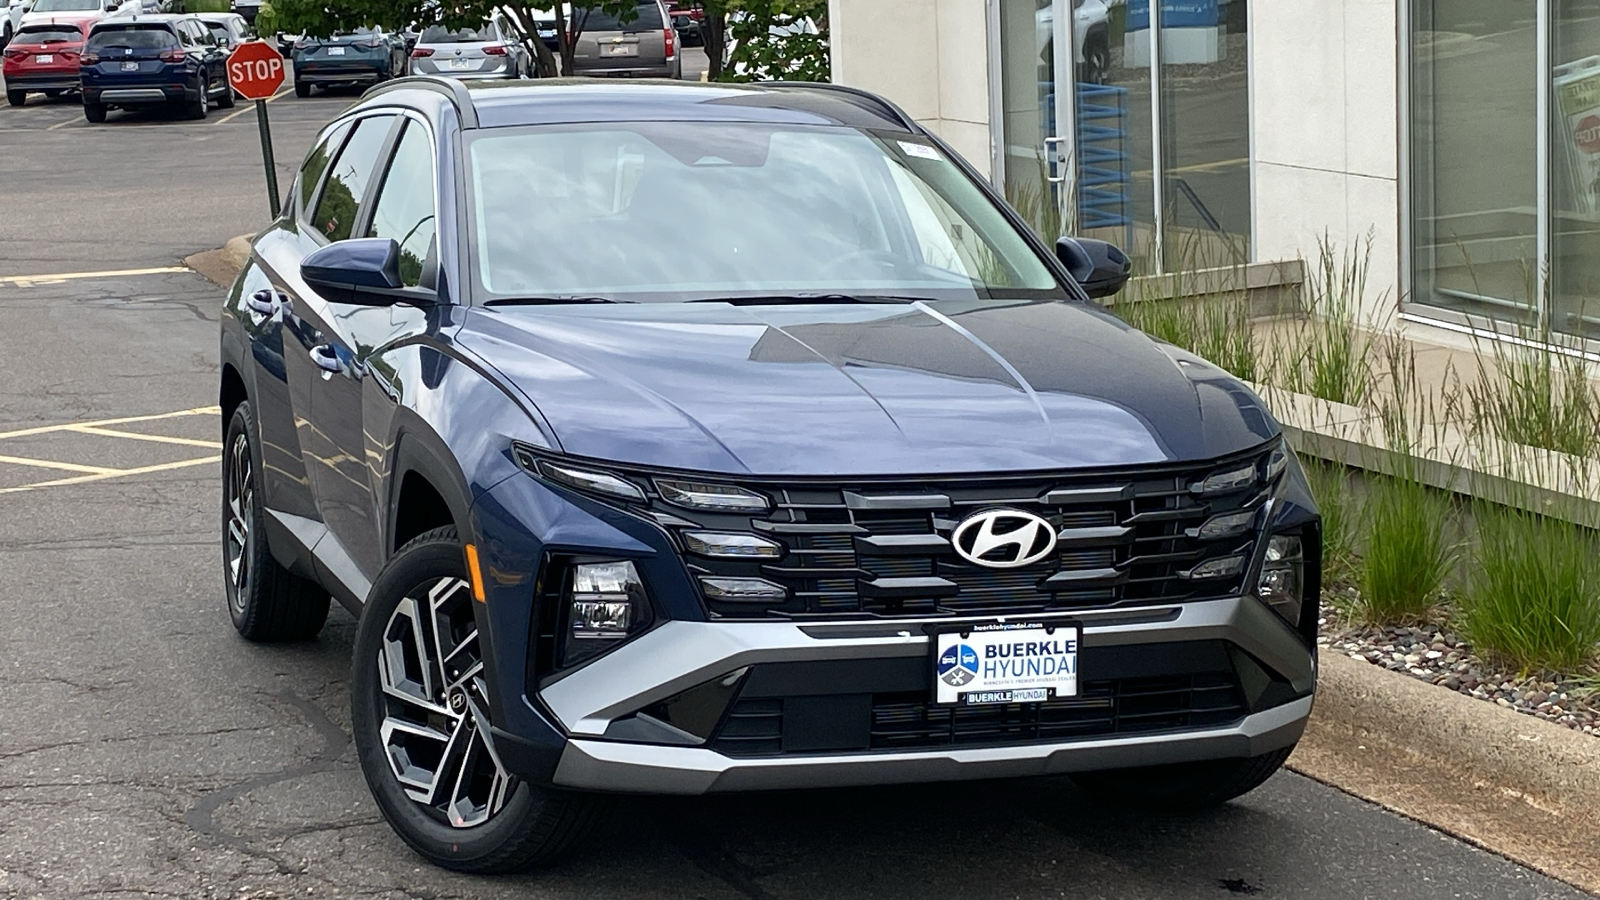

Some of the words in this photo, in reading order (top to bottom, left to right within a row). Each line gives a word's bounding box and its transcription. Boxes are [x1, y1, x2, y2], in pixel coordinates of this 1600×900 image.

[231, 58, 281, 83] STOP
[974, 622, 1043, 631] buerklehyundai.com
[985, 640, 1076, 659] BUERKLE
[984, 655, 1076, 679] HYUNDAI
[968, 690, 1012, 703] BUERKLE
[1013, 690, 1046, 701] HYUNDAI
